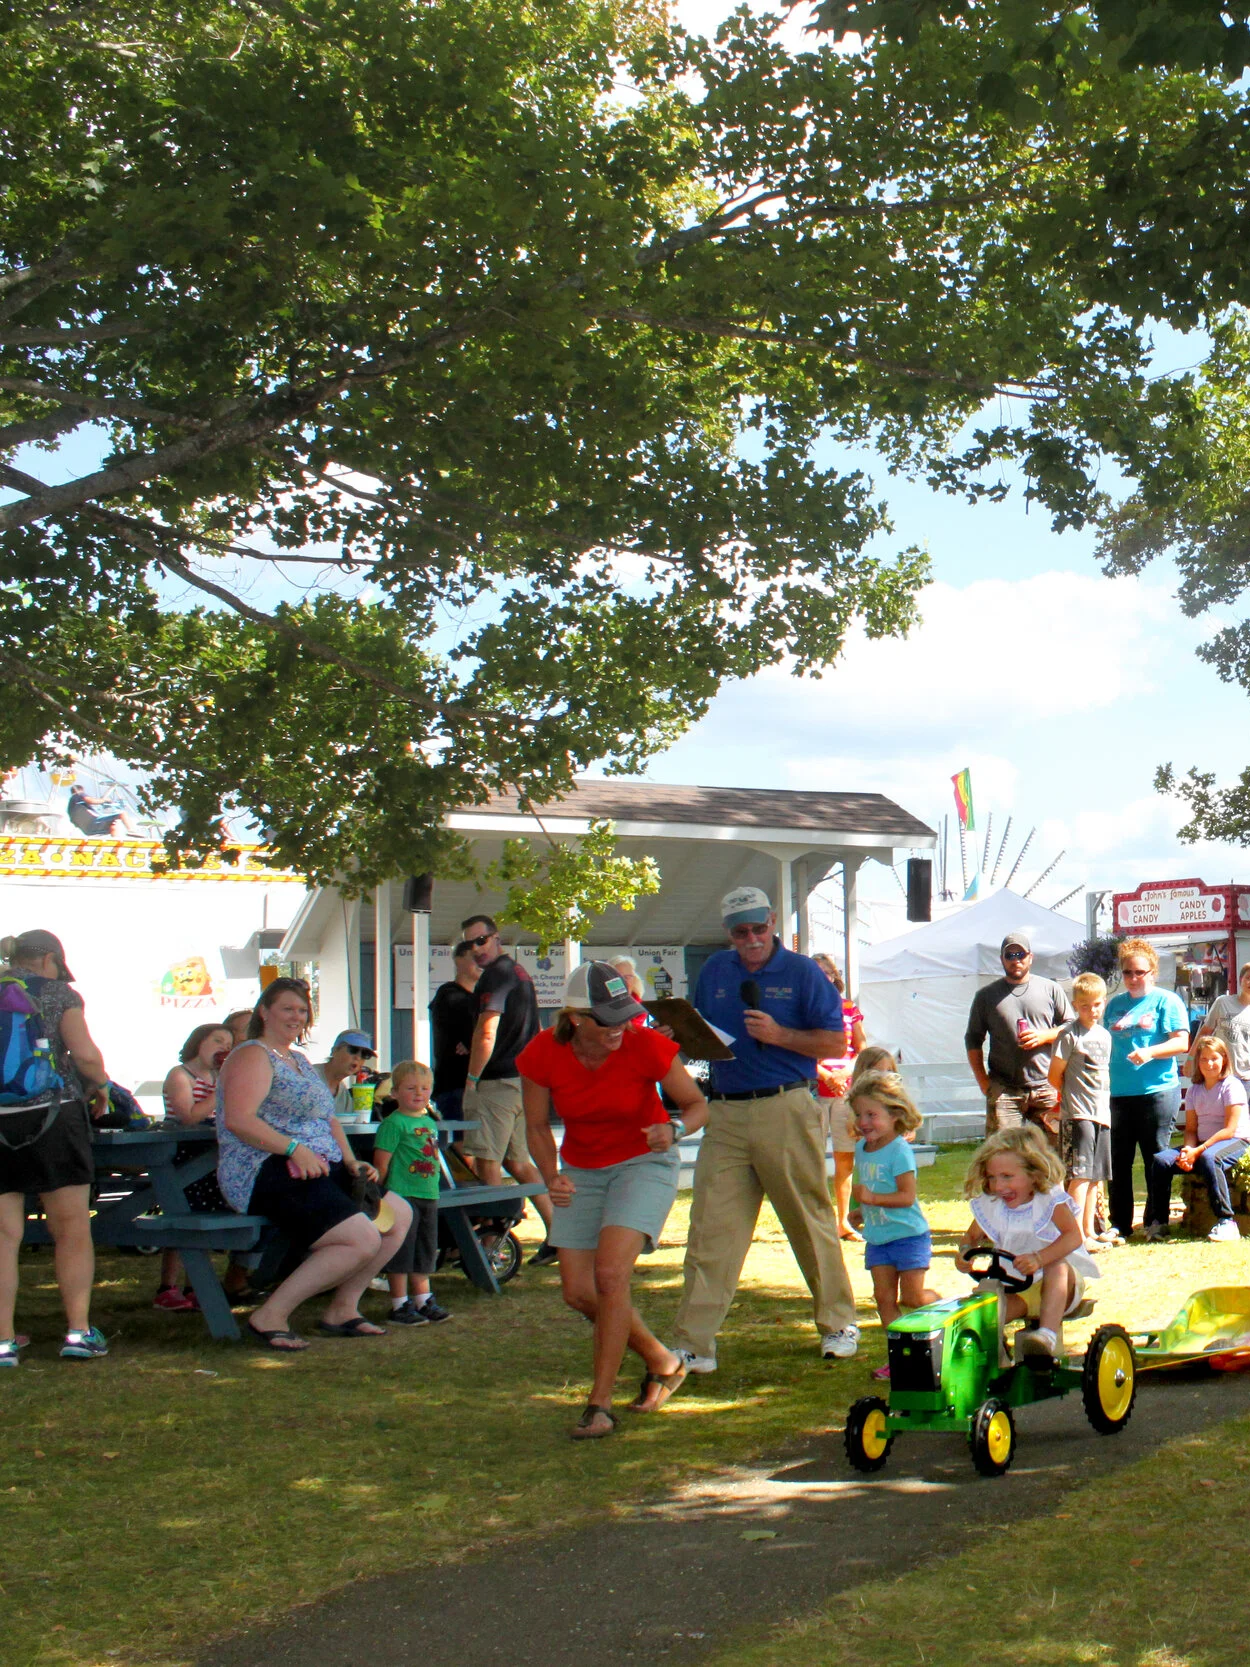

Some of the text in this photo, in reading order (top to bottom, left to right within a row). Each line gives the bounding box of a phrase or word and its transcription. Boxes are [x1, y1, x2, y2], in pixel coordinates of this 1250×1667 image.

[1132, 903, 1160, 913] COTTON
[1179, 900, 1207, 910] CANDY
[1133, 914, 1159, 924] CANDY
[1180, 910, 1207, 921] APPLES
[638, 948, 678, 957] Union Fair
[160, 995, 217, 1009] PIZZA
